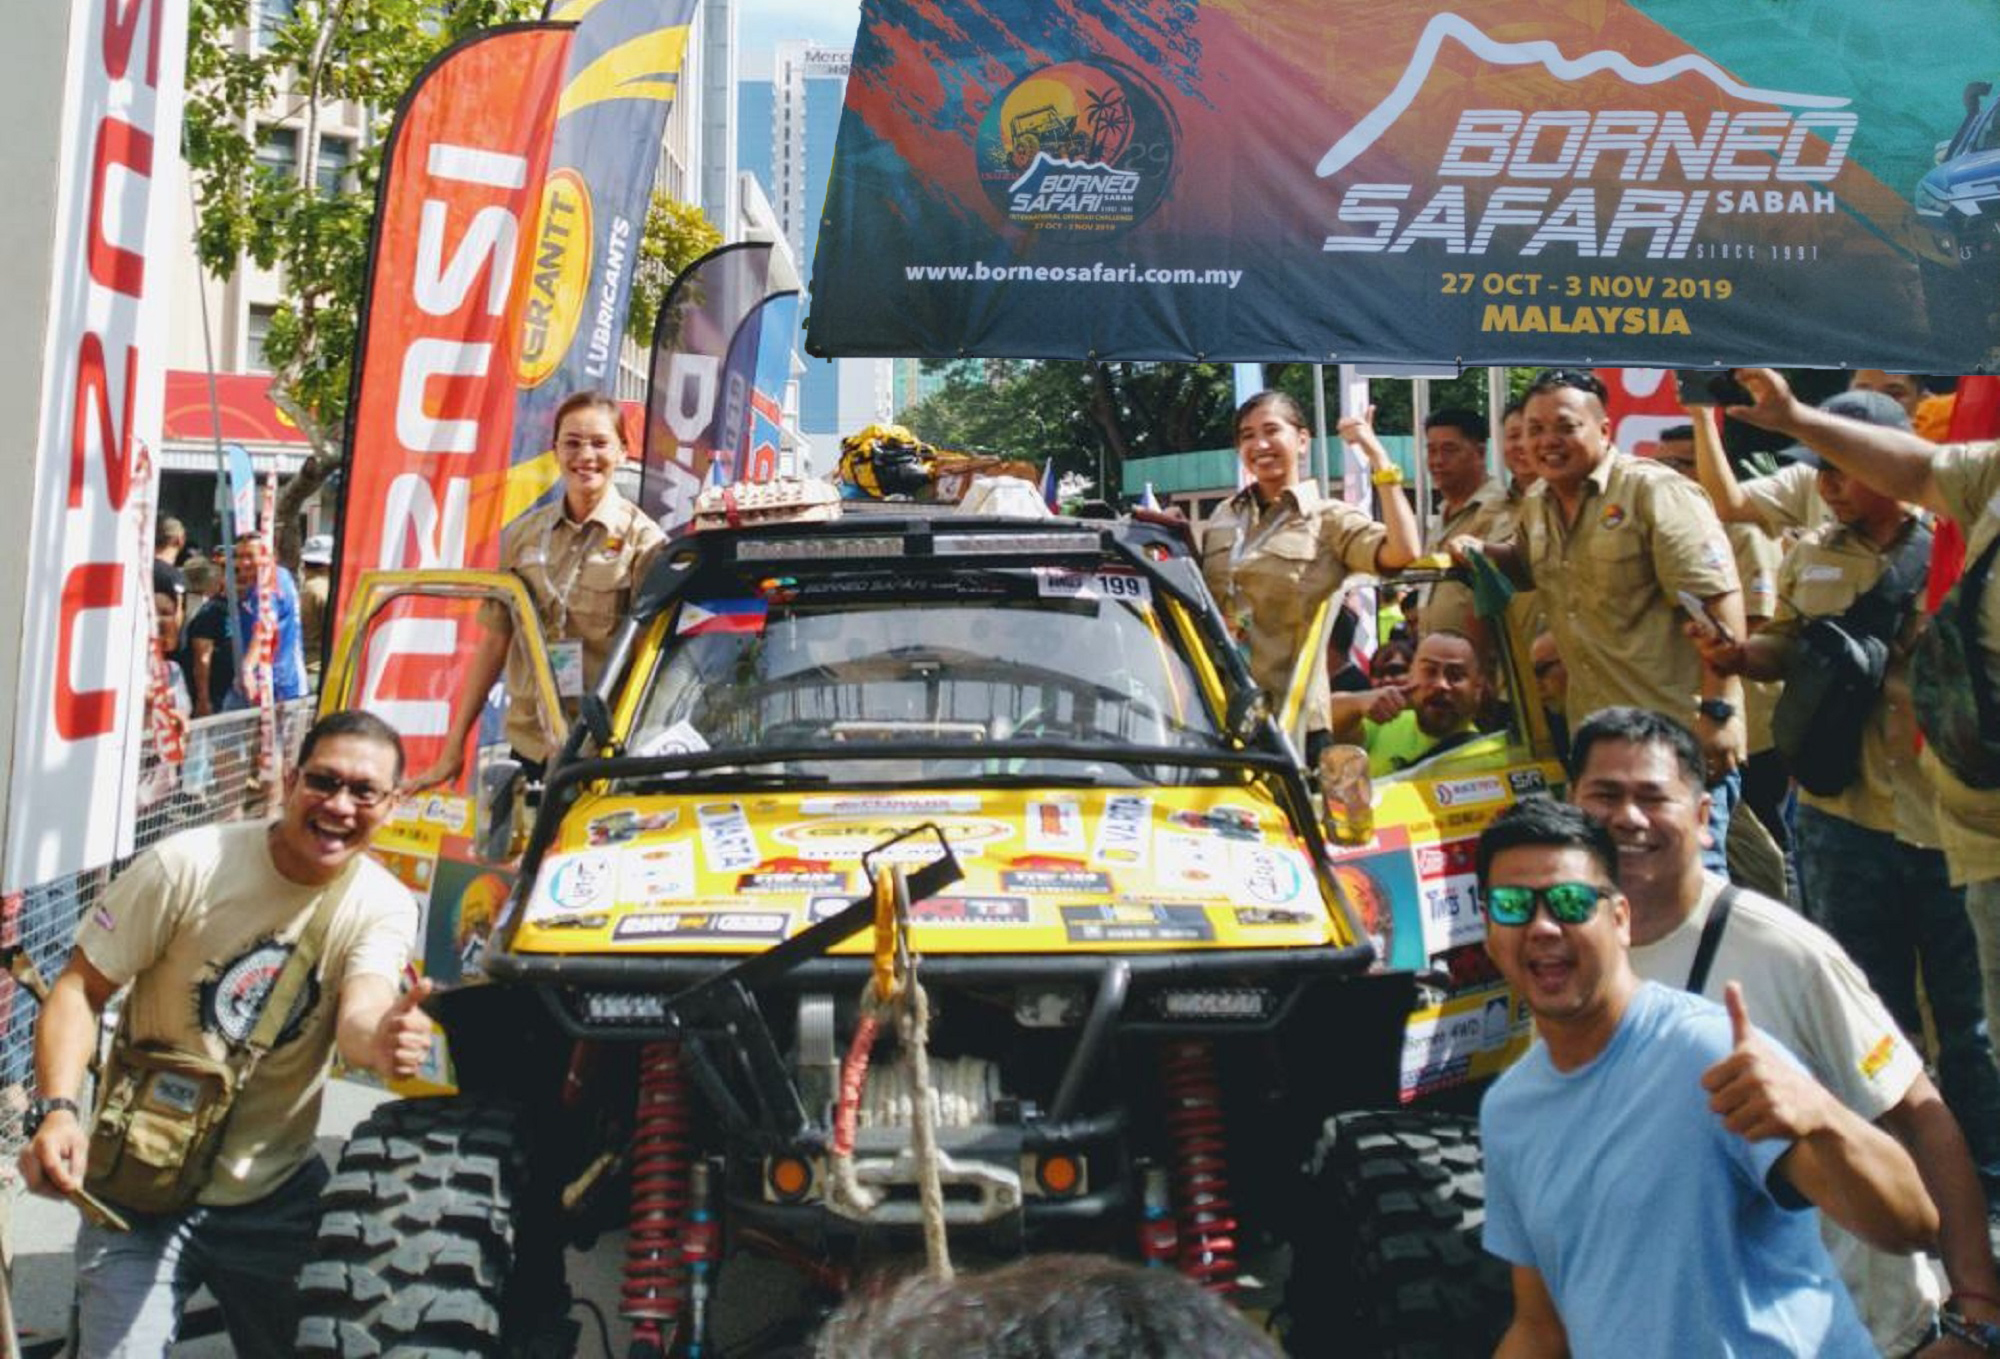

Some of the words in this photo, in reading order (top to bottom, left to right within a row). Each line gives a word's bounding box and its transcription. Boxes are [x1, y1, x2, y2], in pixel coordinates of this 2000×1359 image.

[1438, 109, 1858, 182] BORNEO
[1039, 174, 1141, 194] BORNEO
[1009, 193, 1103, 213] SAFARI
[1715, 190, 1836, 215] SABAH
[1046, 222, 1062, 230] OCT
[1076, 223, 1094, 231] NOV
[1322, 183, 1711, 259] SAFARI
[1696, 243, 1755, 260] SINCE
[1771, 245, 1819, 262] 1991
[521, 190, 576, 363] GRANTT
[905, 261, 1243, 289] www.borneosafari.com.my
[1441, 272, 1476, 294] 27
[1482, 272, 1543, 296] OCT
[1565, 275, 1583, 297] 3
[1589, 276, 1654, 298] NOV
[1661, 277, 1733, 300] 2019
[585, 215, 630, 378] LUBRICANTS
[1480, 304, 1692, 335] MALAYSIA
[361, 143, 527, 736] ISUZU
[1100, 574, 1141, 596] 199
